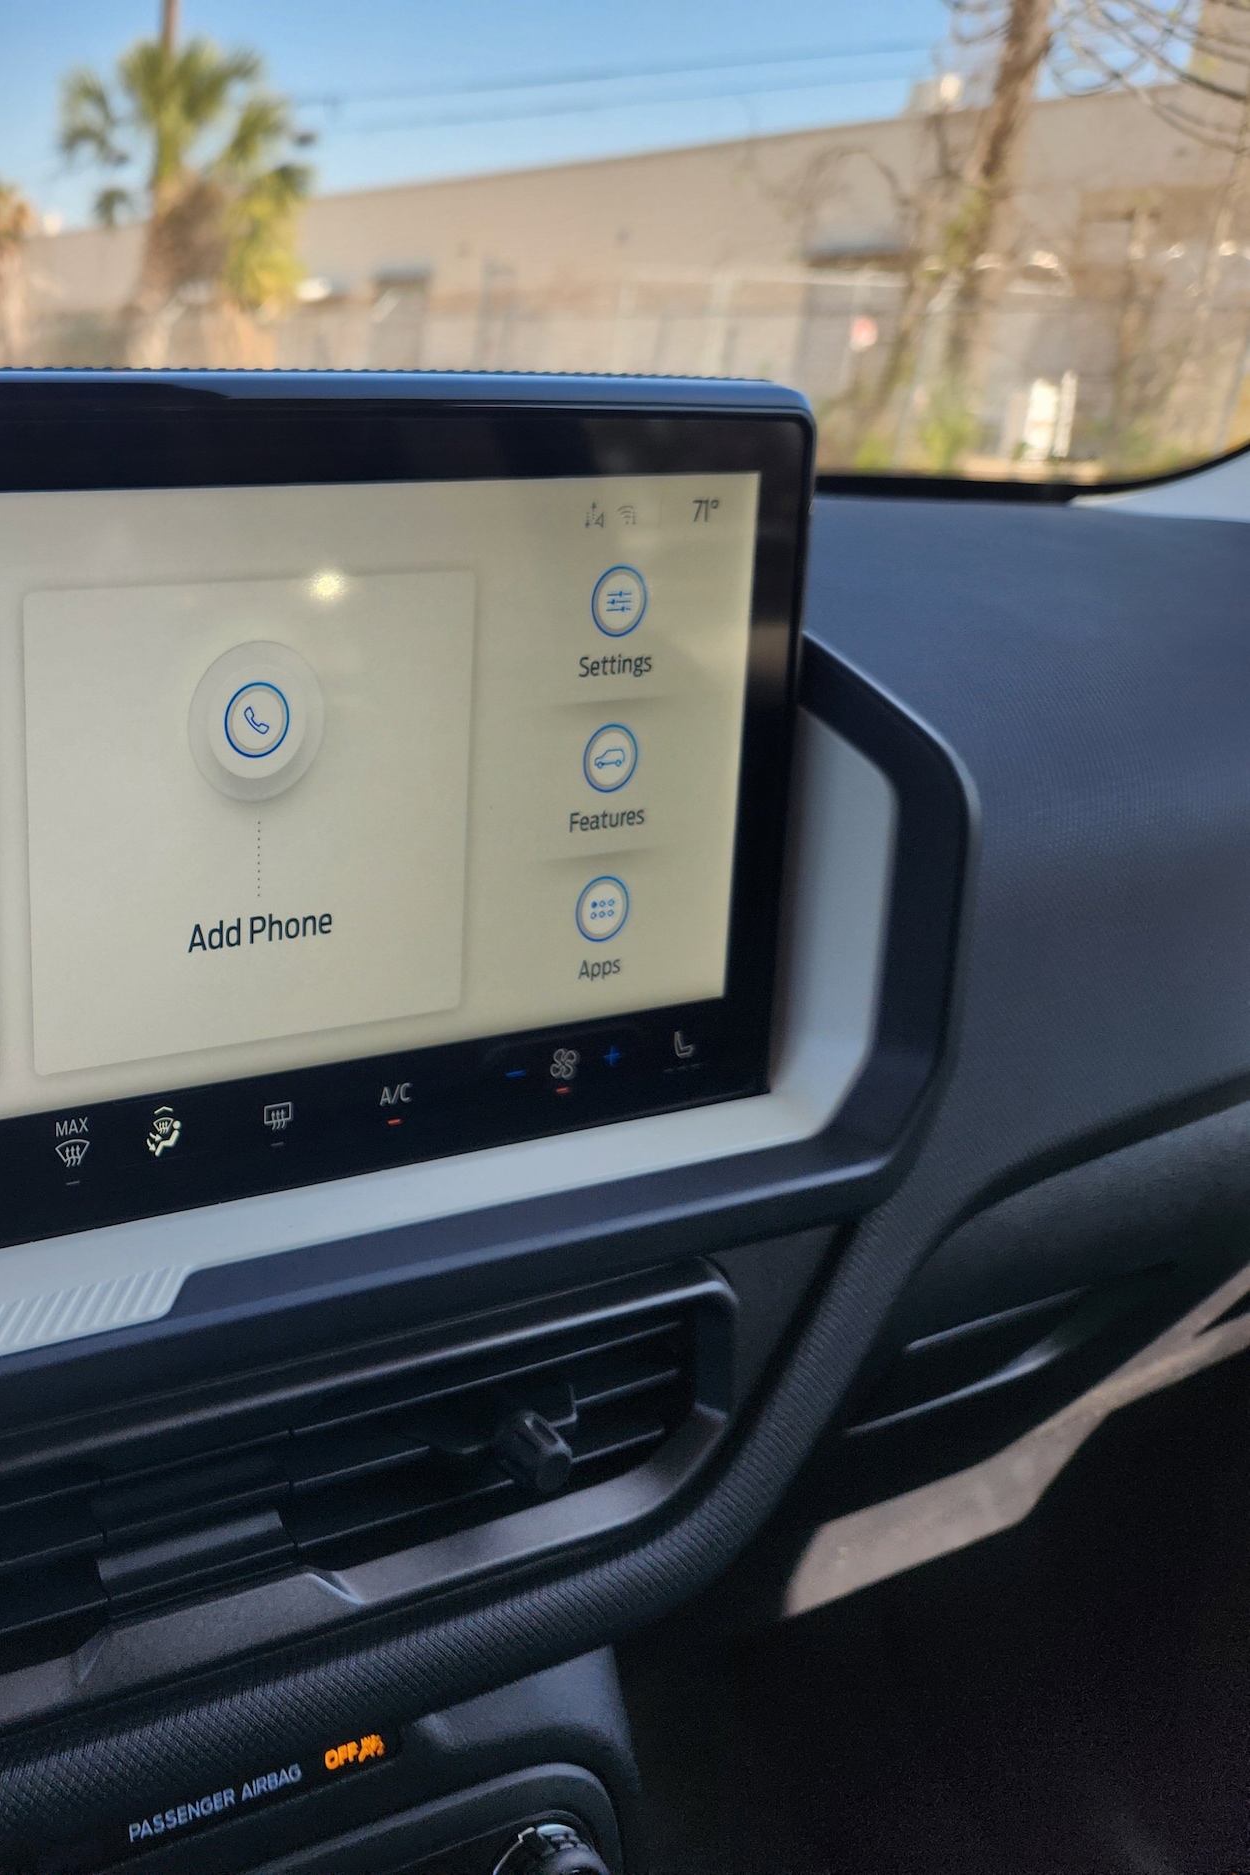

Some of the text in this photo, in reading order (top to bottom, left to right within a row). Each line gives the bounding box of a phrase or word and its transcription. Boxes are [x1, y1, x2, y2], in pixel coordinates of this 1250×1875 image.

[577, 652, 653, 679] Settings
[568, 805, 646, 834] Features
[187, 912, 333, 953] Add Phone
[577, 955, 622, 981] Apps
[379, 1082, 412, 1107] A/C
[54, 1116, 89, 1138] MAX
[324, 1740, 360, 1770] OFF
[128, 1762, 302, 1844] PASSENGER AIRBAG
